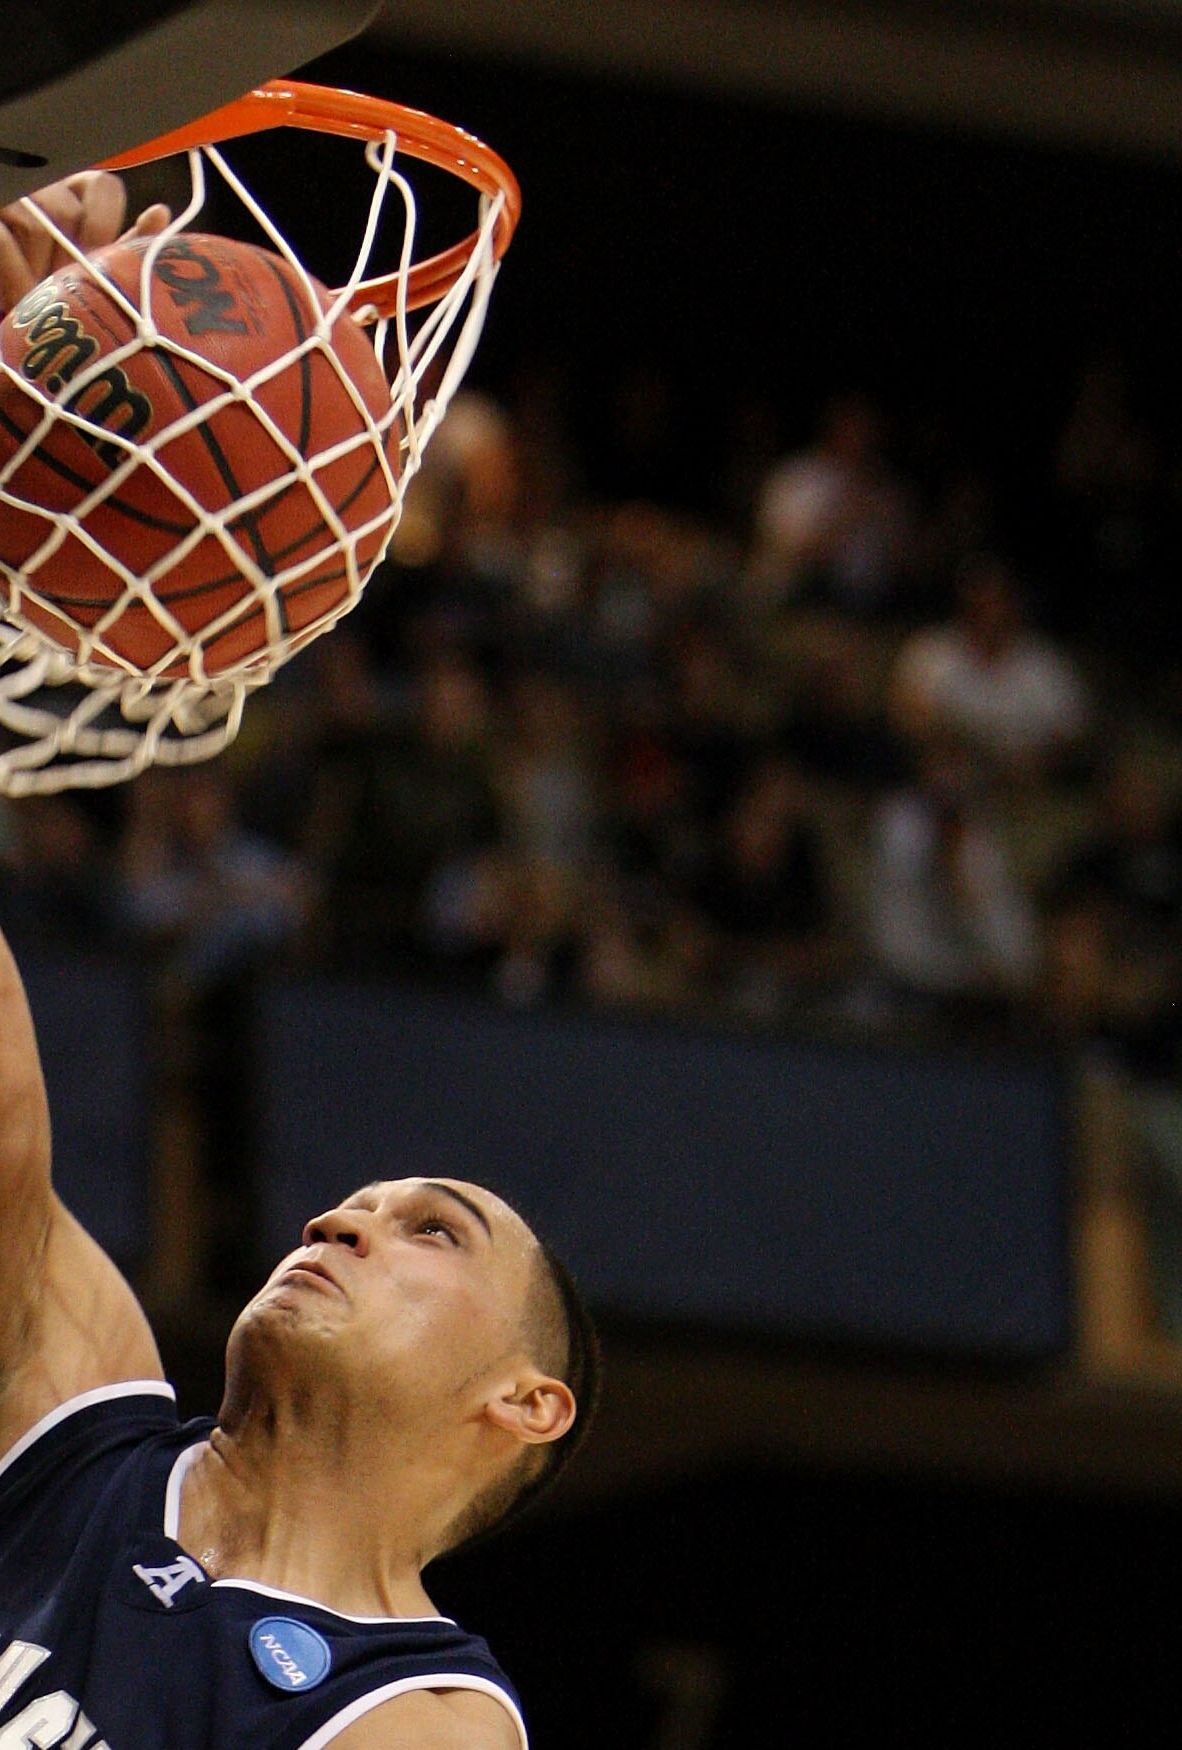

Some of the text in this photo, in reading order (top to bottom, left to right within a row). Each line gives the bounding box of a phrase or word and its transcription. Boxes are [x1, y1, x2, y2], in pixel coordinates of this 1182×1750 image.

[150, 238, 248, 336] NCA
[13, 274, 154, 471] Wilso
[131, 1554, 206, 1609] A
[259, 1633, 308, 1687] NCAA
